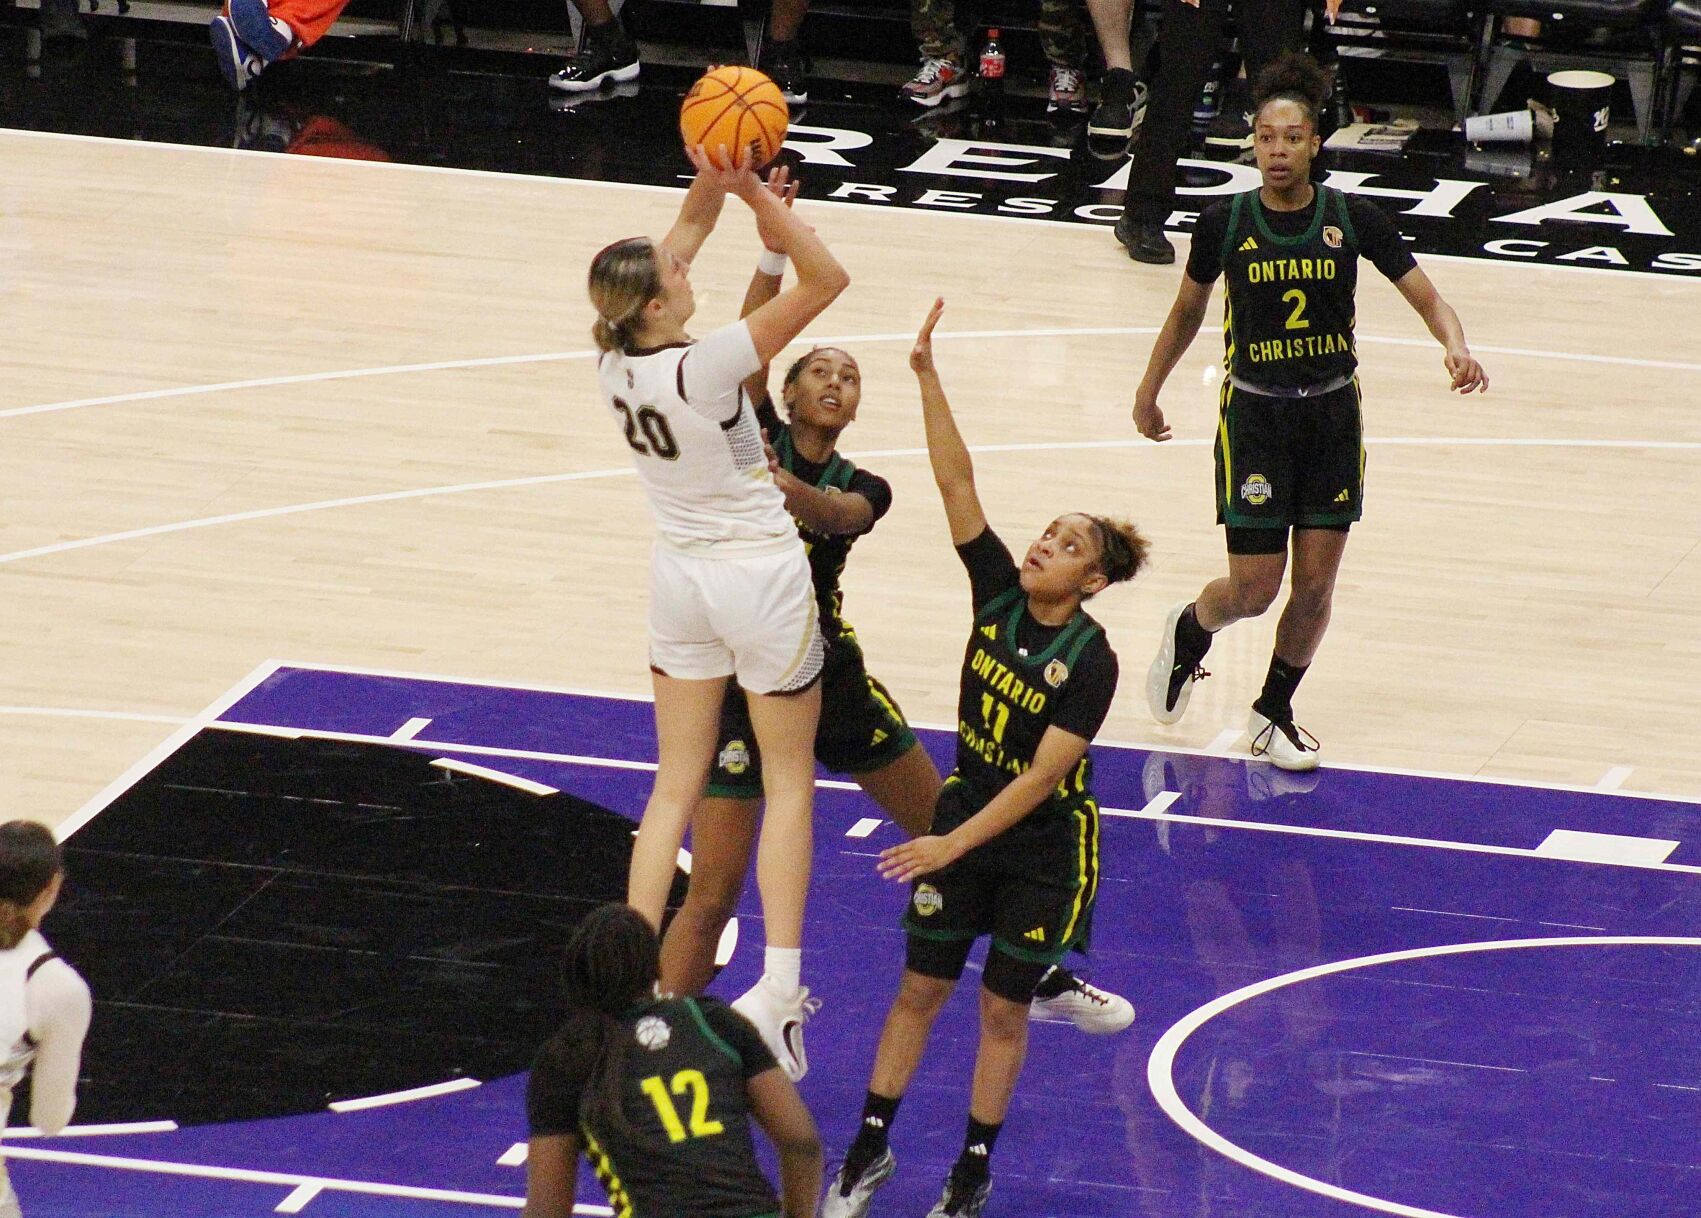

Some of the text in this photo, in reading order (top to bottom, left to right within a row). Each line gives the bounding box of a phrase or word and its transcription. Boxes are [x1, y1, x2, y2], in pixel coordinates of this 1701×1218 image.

[1248, 259, 1336, 283] ONTARIO
[1281, 288, 1310, 330] 2
[1249, 333, 1349, 362] CHRISTIAN
[612, 395, 682, 461] 20
[971, 648, 1046, 714] ONTARIO
[981, 691, 1010, 744] 11
[640, 1069, 725, 1143] 12
